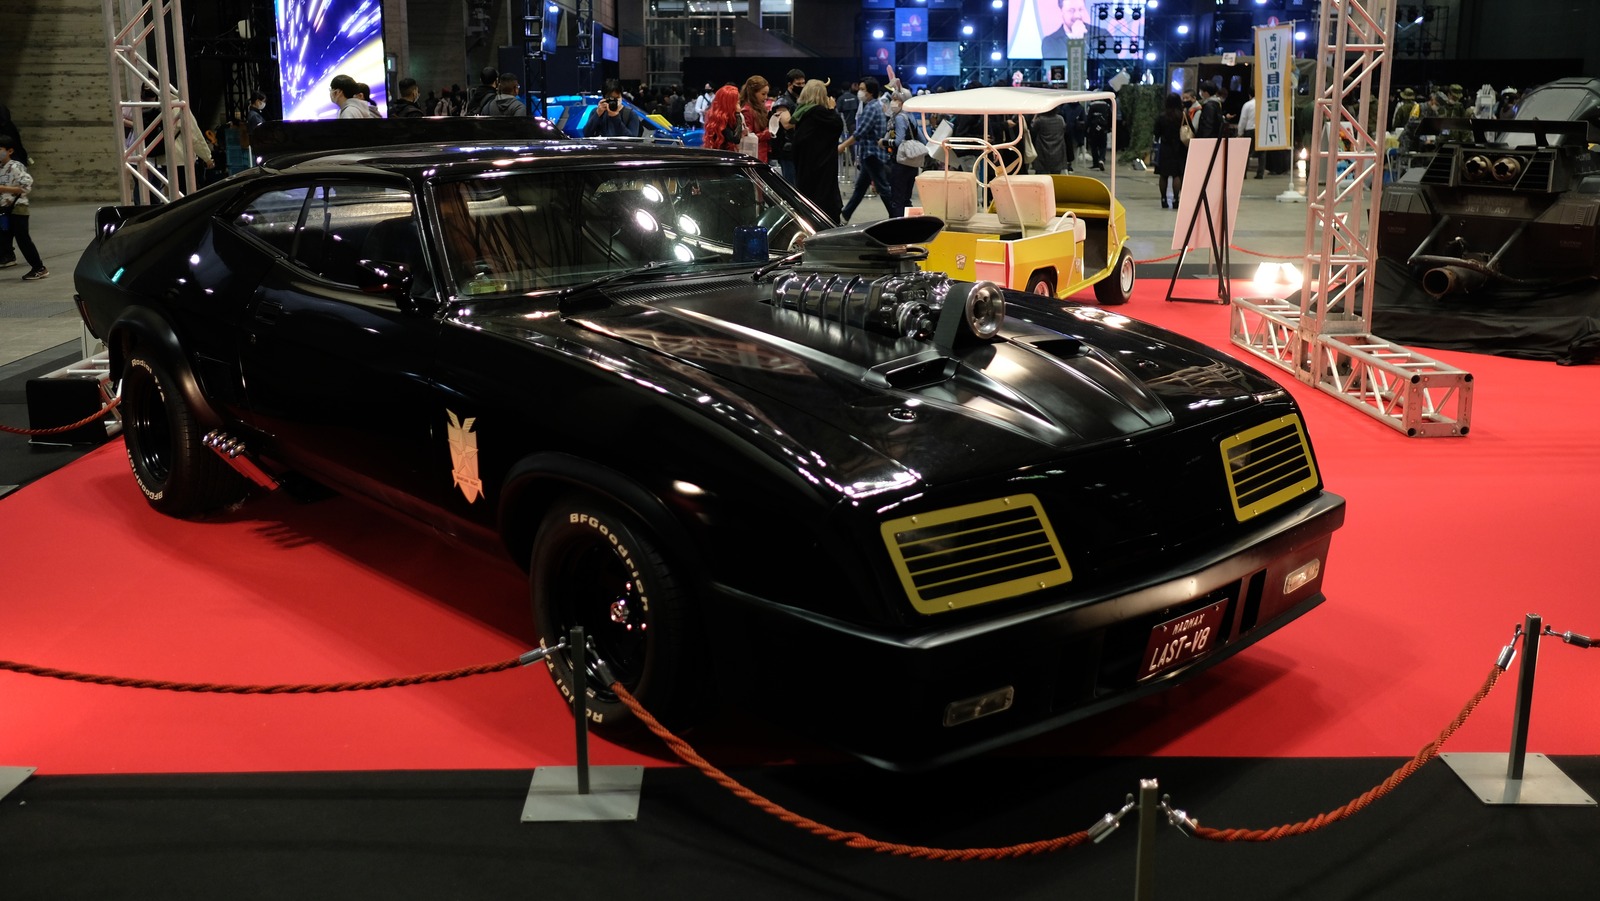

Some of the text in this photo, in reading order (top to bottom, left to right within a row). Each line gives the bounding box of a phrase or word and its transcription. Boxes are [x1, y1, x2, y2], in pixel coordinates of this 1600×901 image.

[127, 448, 163, 501] BFGoodrich
[570, 513, 649, 612] BFGoodrich
[1172, 613, 1205, 635] MADMAX
[1149, 626, 1211, 671] LAST-V8
[556, 679, 604, 723] Raial
